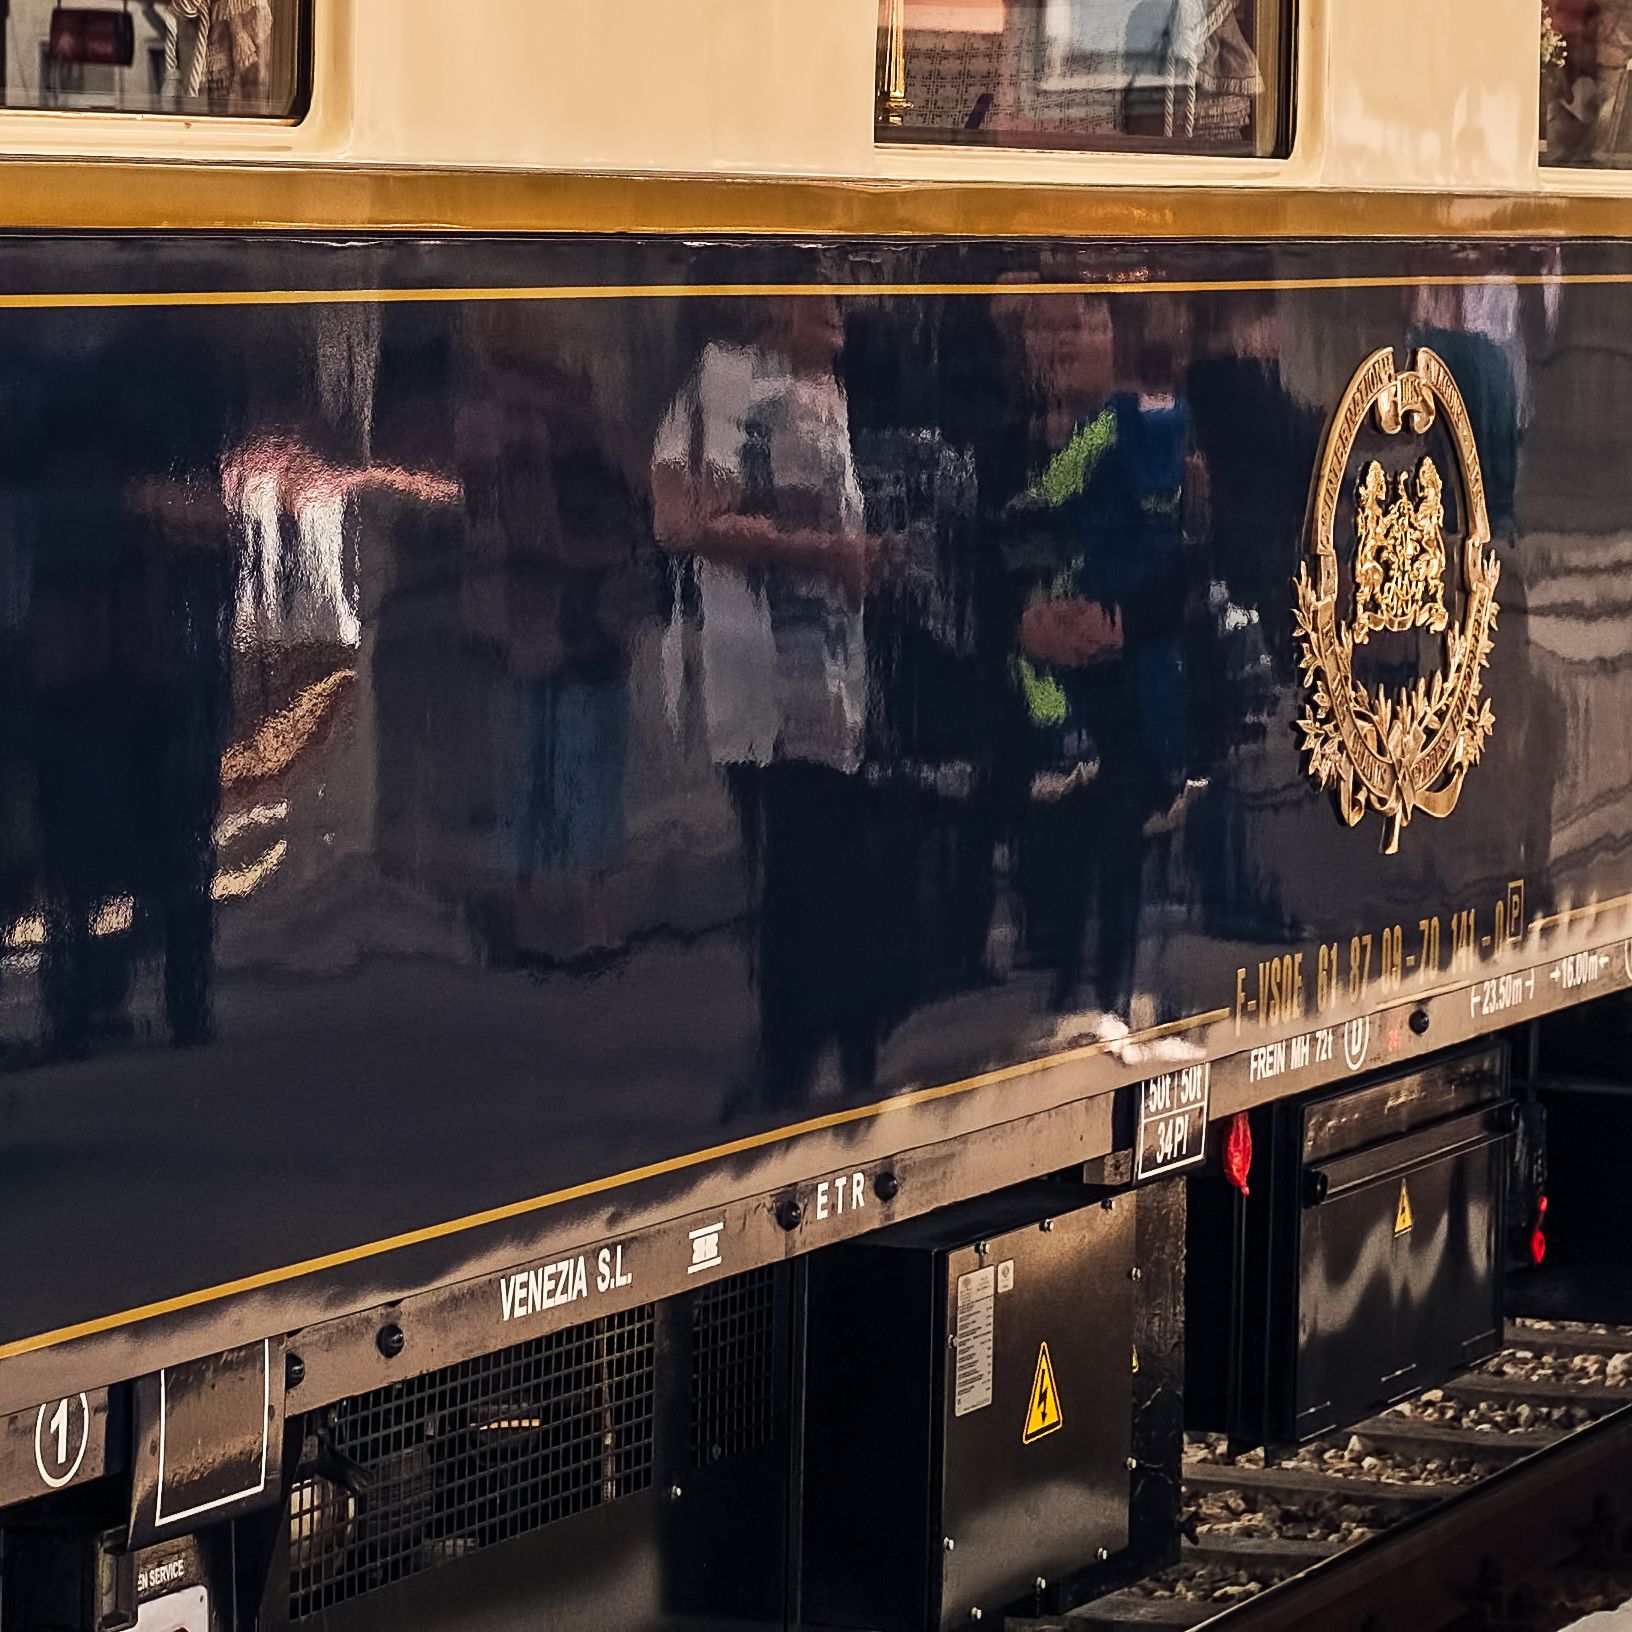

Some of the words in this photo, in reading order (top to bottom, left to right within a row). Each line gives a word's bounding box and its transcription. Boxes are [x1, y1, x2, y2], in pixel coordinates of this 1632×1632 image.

[1349, 934, 1372, 1003] 87
[1250, 1042, 1286, 1083] FREIN
[1290, 1033, 1310, 1069] MH
[500, 1255, 587, 1322] VENEZIA
[597, 1245, 633, 1293] S.L.
[50, 1398, 68, 1465] 1
[148, 1559, 184, 1587] SERVICE
